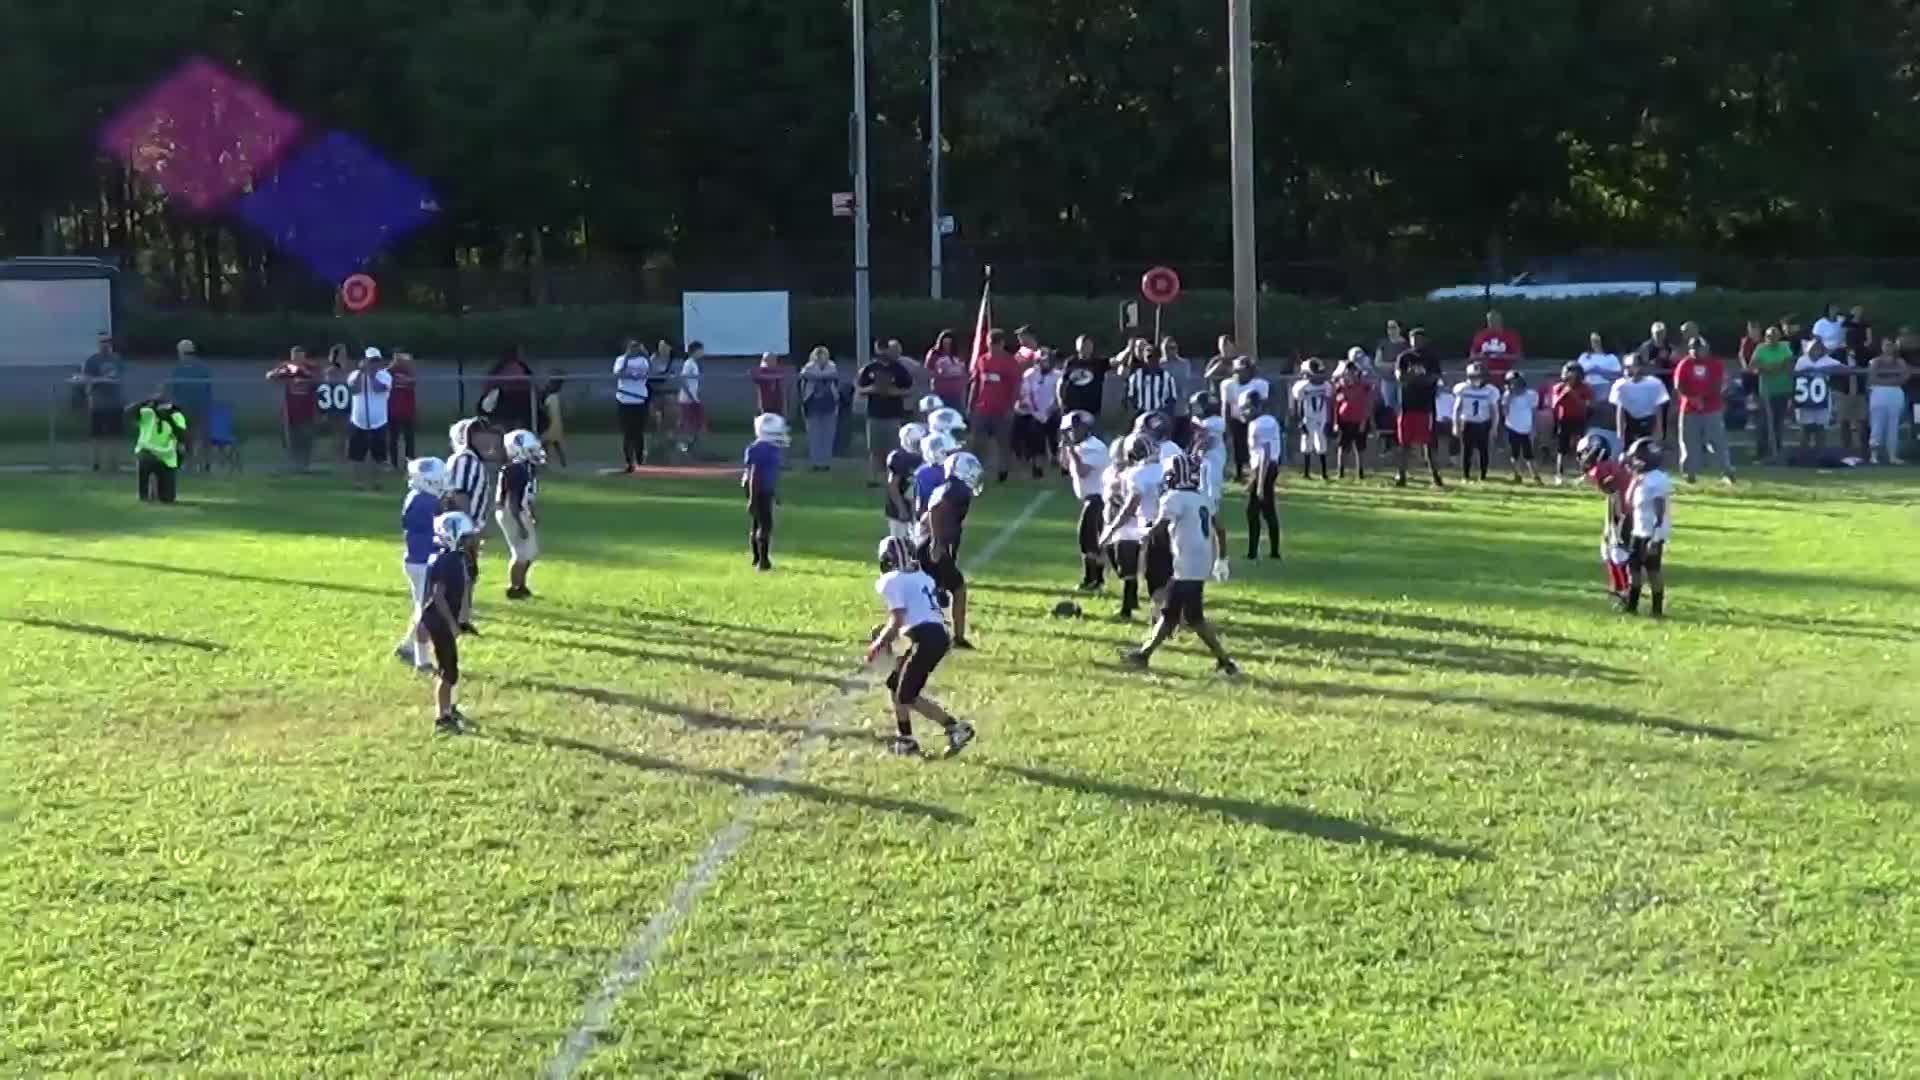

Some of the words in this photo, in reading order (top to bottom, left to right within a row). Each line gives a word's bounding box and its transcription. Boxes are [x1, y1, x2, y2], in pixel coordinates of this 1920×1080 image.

[317, 383, 349, 410] 30
[1794, 376, 1827, 404] 50
[1472, 399, 1480, 417] 1
